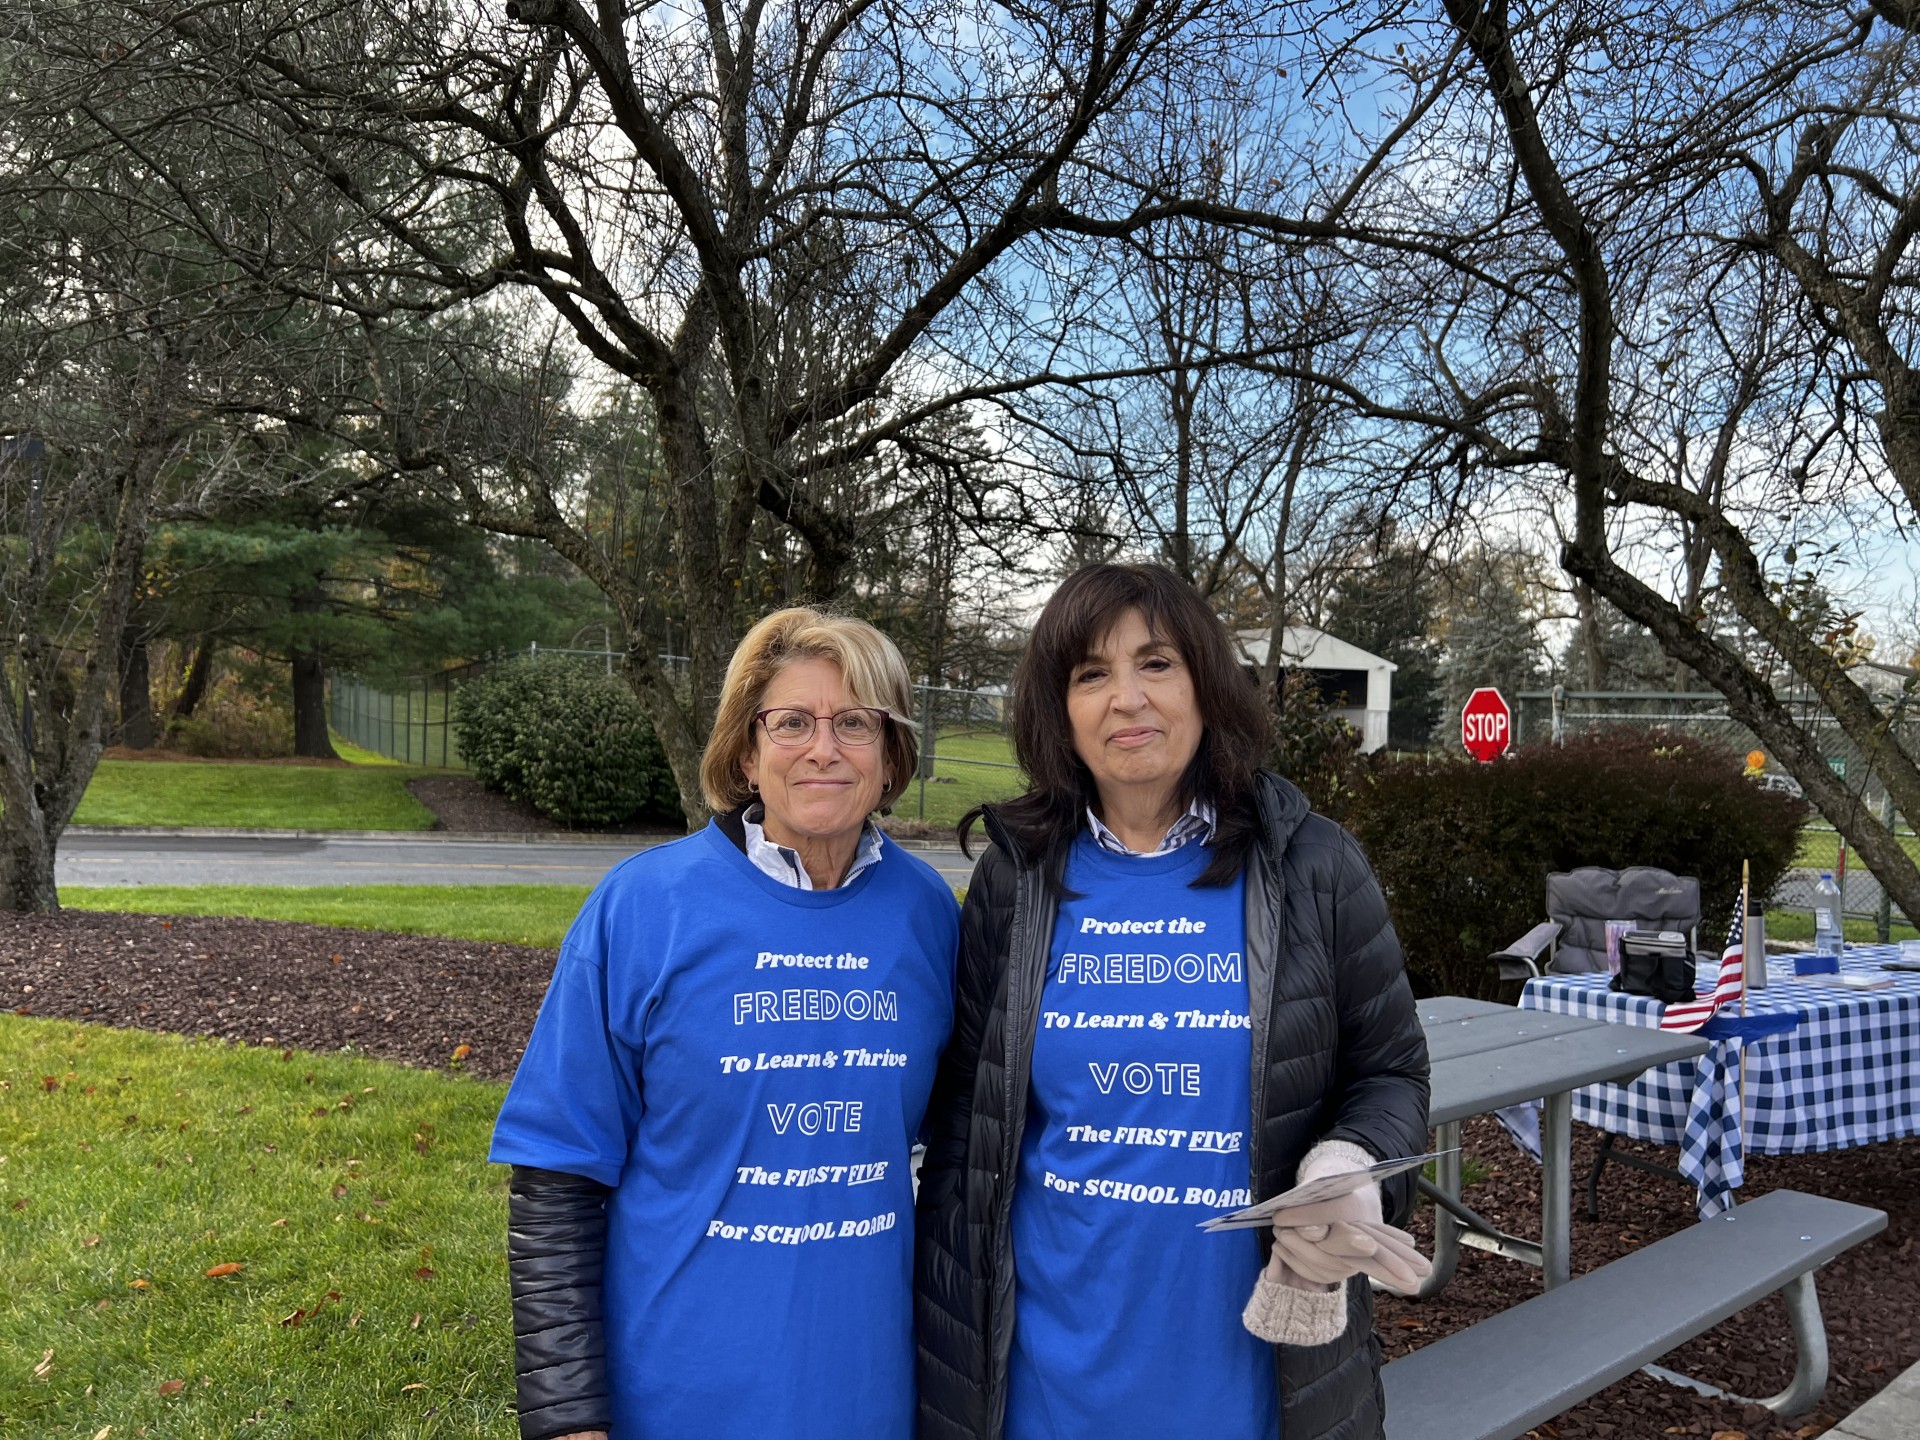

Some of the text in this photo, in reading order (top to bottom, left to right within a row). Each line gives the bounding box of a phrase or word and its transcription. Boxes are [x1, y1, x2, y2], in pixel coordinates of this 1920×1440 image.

[1465, 712, 1507, 742] STOP
[1079, 916, 1207, 935] Protect the
[754, 951, 869, 970] Protect the
[1057, 952, 1242, 985] FREEDOM
[733, 988, 898, 1026] FREEDOM
[1043, 1011, 1071, 1029] To
[1073, 1011, 1145, 1029] Learn
[1147, 1011, 1170, 1030] &
[719, 1055, 752, 1074] To
[842, 1048, 908, 1068] Thrive
[1088, 1062, 1201, 1097] VOTE
[766, 1100, 863, 1136] VOTE
[1066, 1125, 1243, 1152] The FIRST FIVE
[736, 1161, 889, 1187] The FIRST FIVE
[1043, 1171, 1081, 1194] For
[1083, 1178, 1180, 1205] SCHOOL
[706, 1211, 896, 1246] For SCHOOL BOARD
